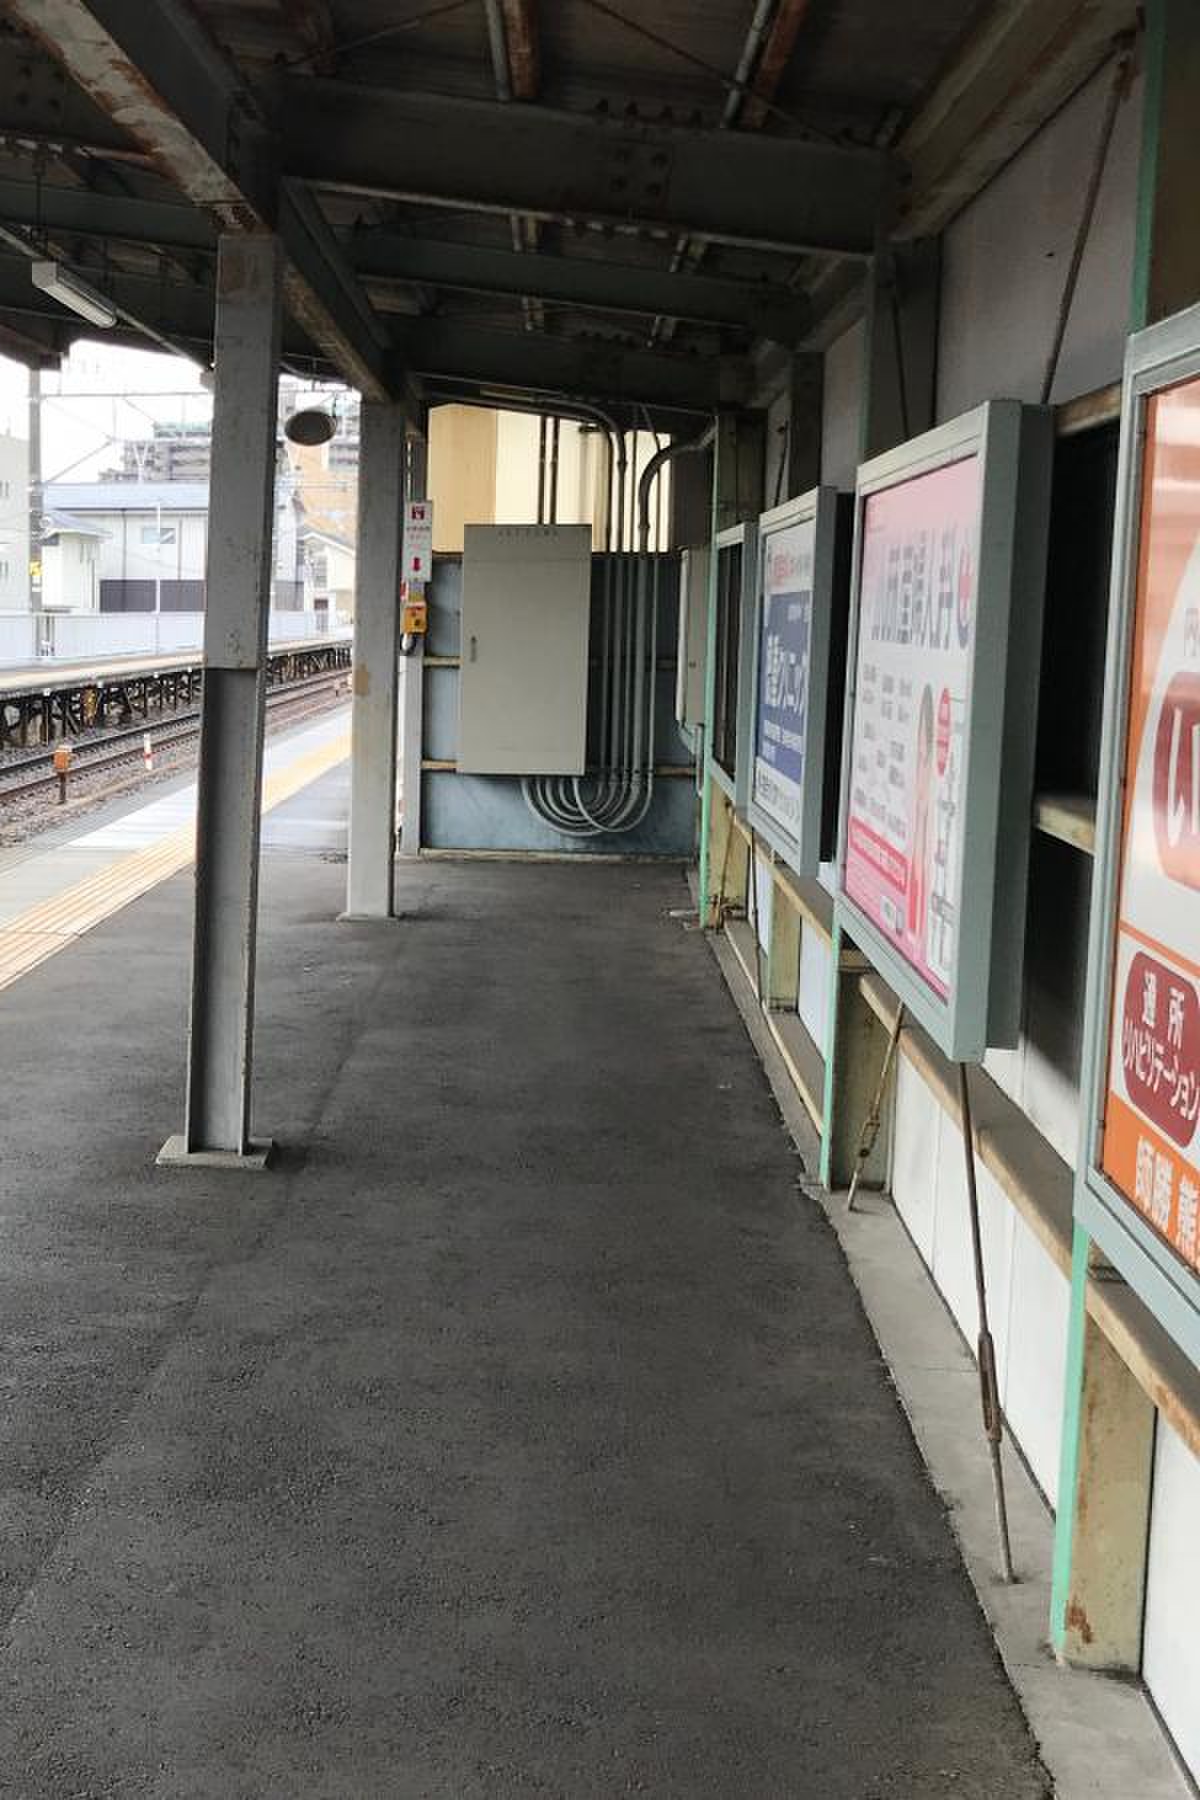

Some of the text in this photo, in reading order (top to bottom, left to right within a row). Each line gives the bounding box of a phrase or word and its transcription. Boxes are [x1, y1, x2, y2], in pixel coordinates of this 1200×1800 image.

[1141, 970, 1185, 1050] 通所
[1123, 1017, 1200, 1122] リハビリテーション
